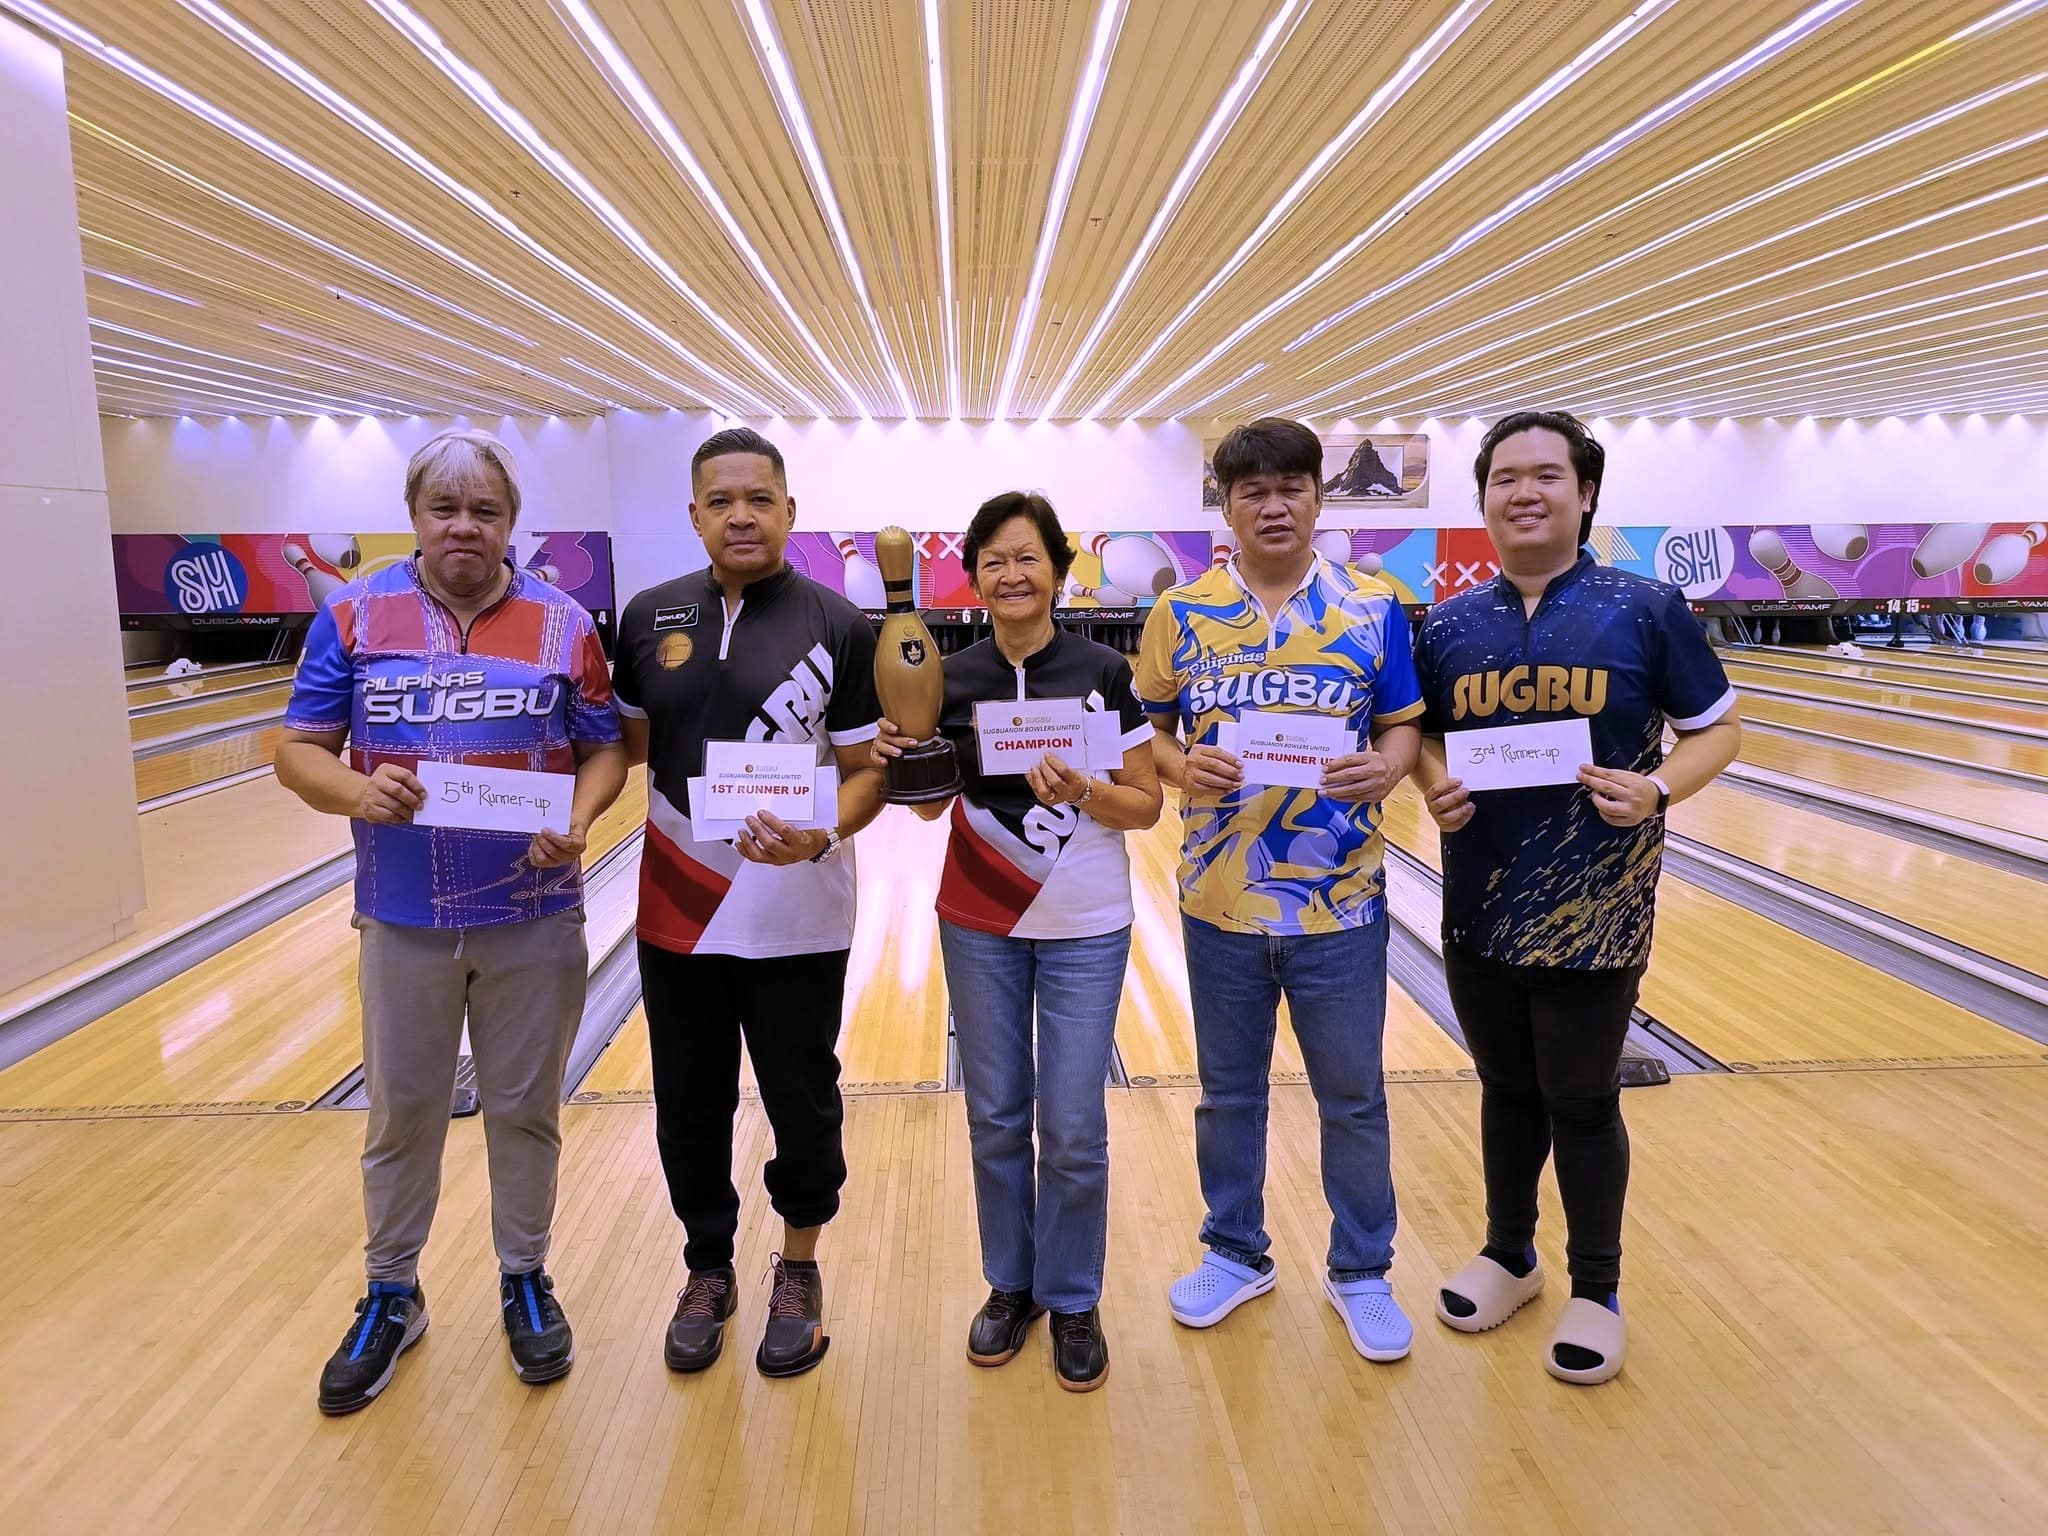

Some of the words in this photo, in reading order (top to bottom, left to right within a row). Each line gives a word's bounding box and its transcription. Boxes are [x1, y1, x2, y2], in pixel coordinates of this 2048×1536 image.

[1665, 528, 1722, 588] SM
[171, 550, 240, 613] SM
[1886, 599, 1901, 613] 14
[1905, 599, 1920, 613] 15
[962, 609, 971, 623] 6
[981, 610, 989, 623] 7
[1188, 651, 1266, 677] Pilipinas
[363, 671, 486, 692] PILIPINAS
[1452, 665, 1609, 721] SUGBU
[364, 683, 560, 724] SUGBU
[1024, 716, 1052, 724] SUGBU
[983, 727, 1024, 735] SUGBUANON
[1025, 725, 1055, 733] BOWLERS
[994, 738, 1073, 751] CHAMPION
[1250, 740, 1284, 748] SUGBUANON
[1242, 750, 1264, 760] 2nd
[1267, 753, 1317, 765] RUNNER
[1320, 757, 1335, 767] U
[1469, 744, 1496, 765] 3rd
[1501, 743, 1560, 764] Runner-up
[441, 781, 473, 803] 5th
[479, 784, 551, 817] Runner-up
[711, 784, 734, 794] 1ST
[737, 785, 790, 795] RUNNER
[793, 786, 810, 795] UP
